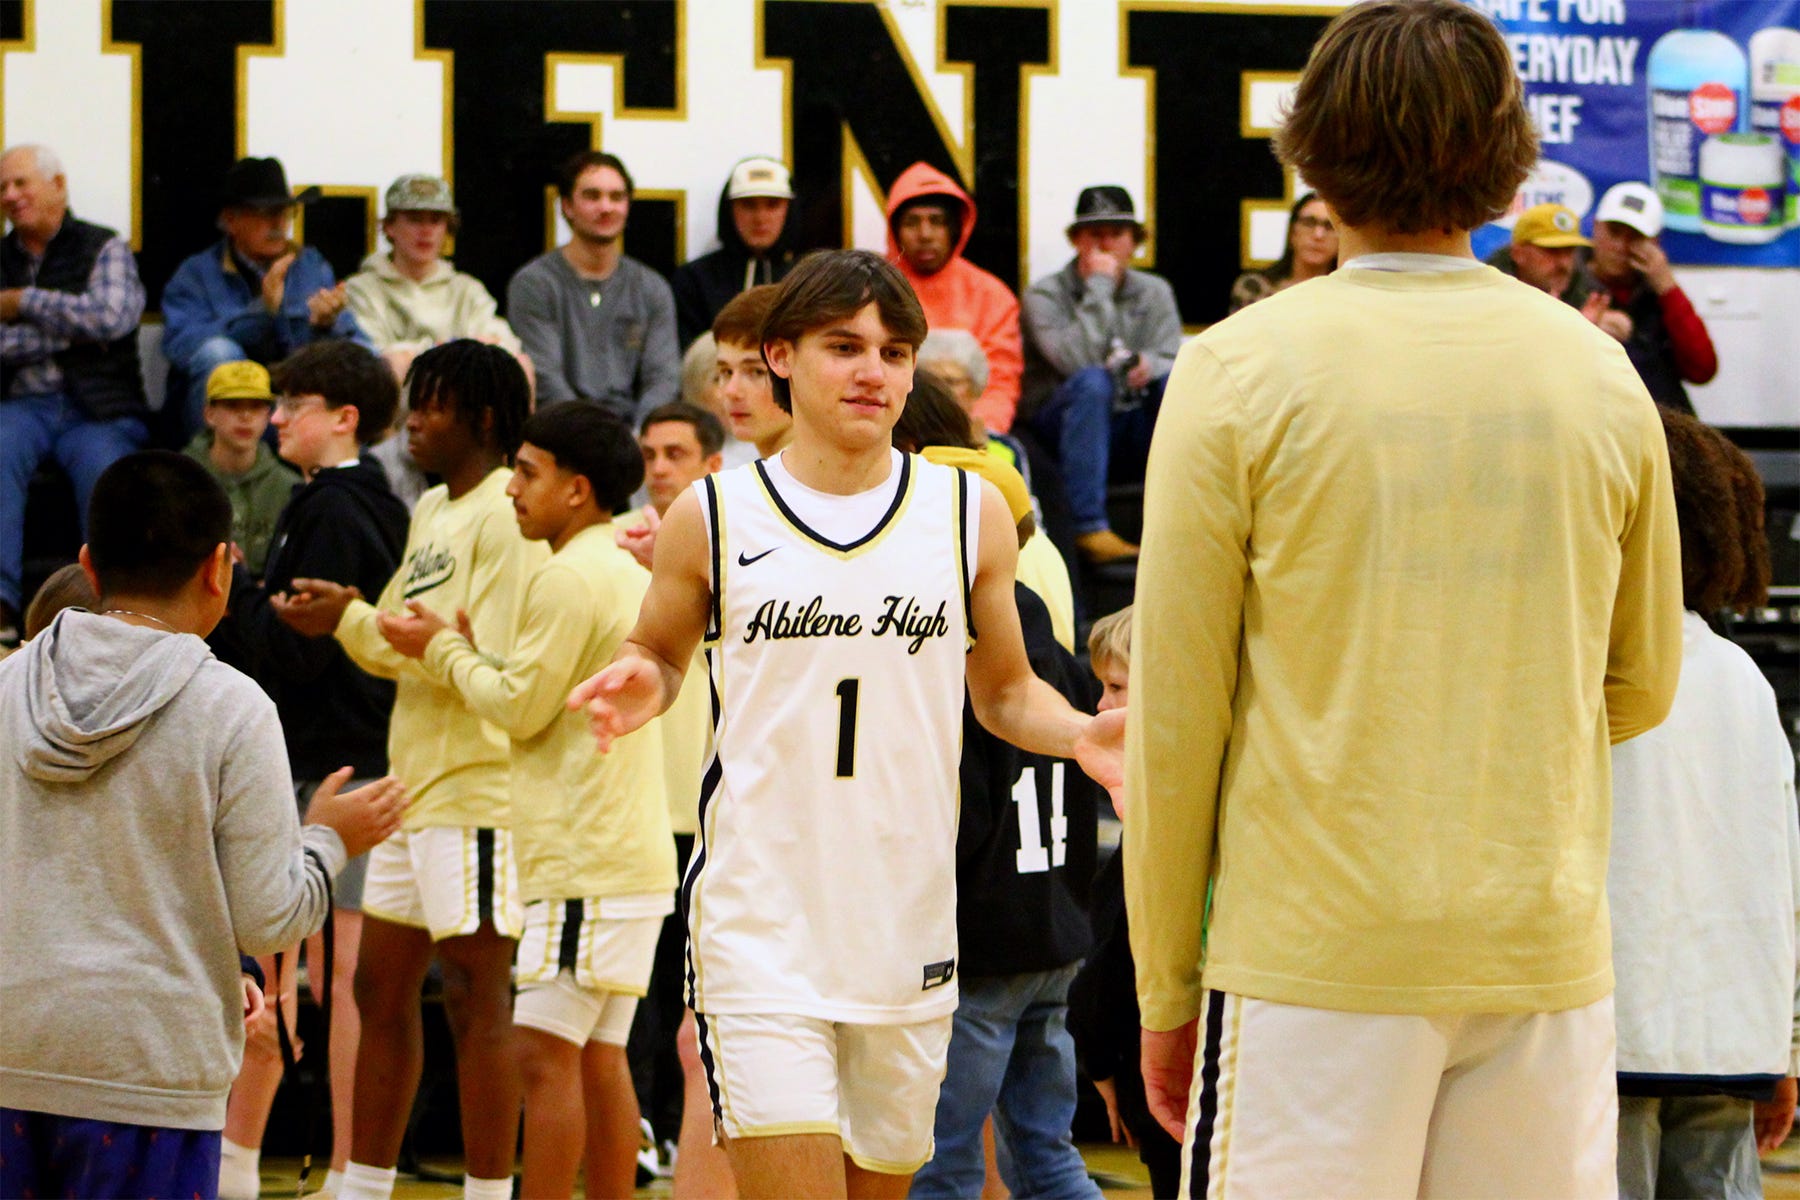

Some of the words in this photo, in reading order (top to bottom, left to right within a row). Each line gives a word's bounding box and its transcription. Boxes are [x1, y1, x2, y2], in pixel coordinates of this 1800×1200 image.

[1502, 33, 1640, 85] ERYDAY
[1528, 94, 1583, 144] IEF
[0, 0, 1348, 334] LENE
[743, 595, 863, 644] Abilene
[871, 595, 949, 655] High
[833, 676, 861, 780] 1
